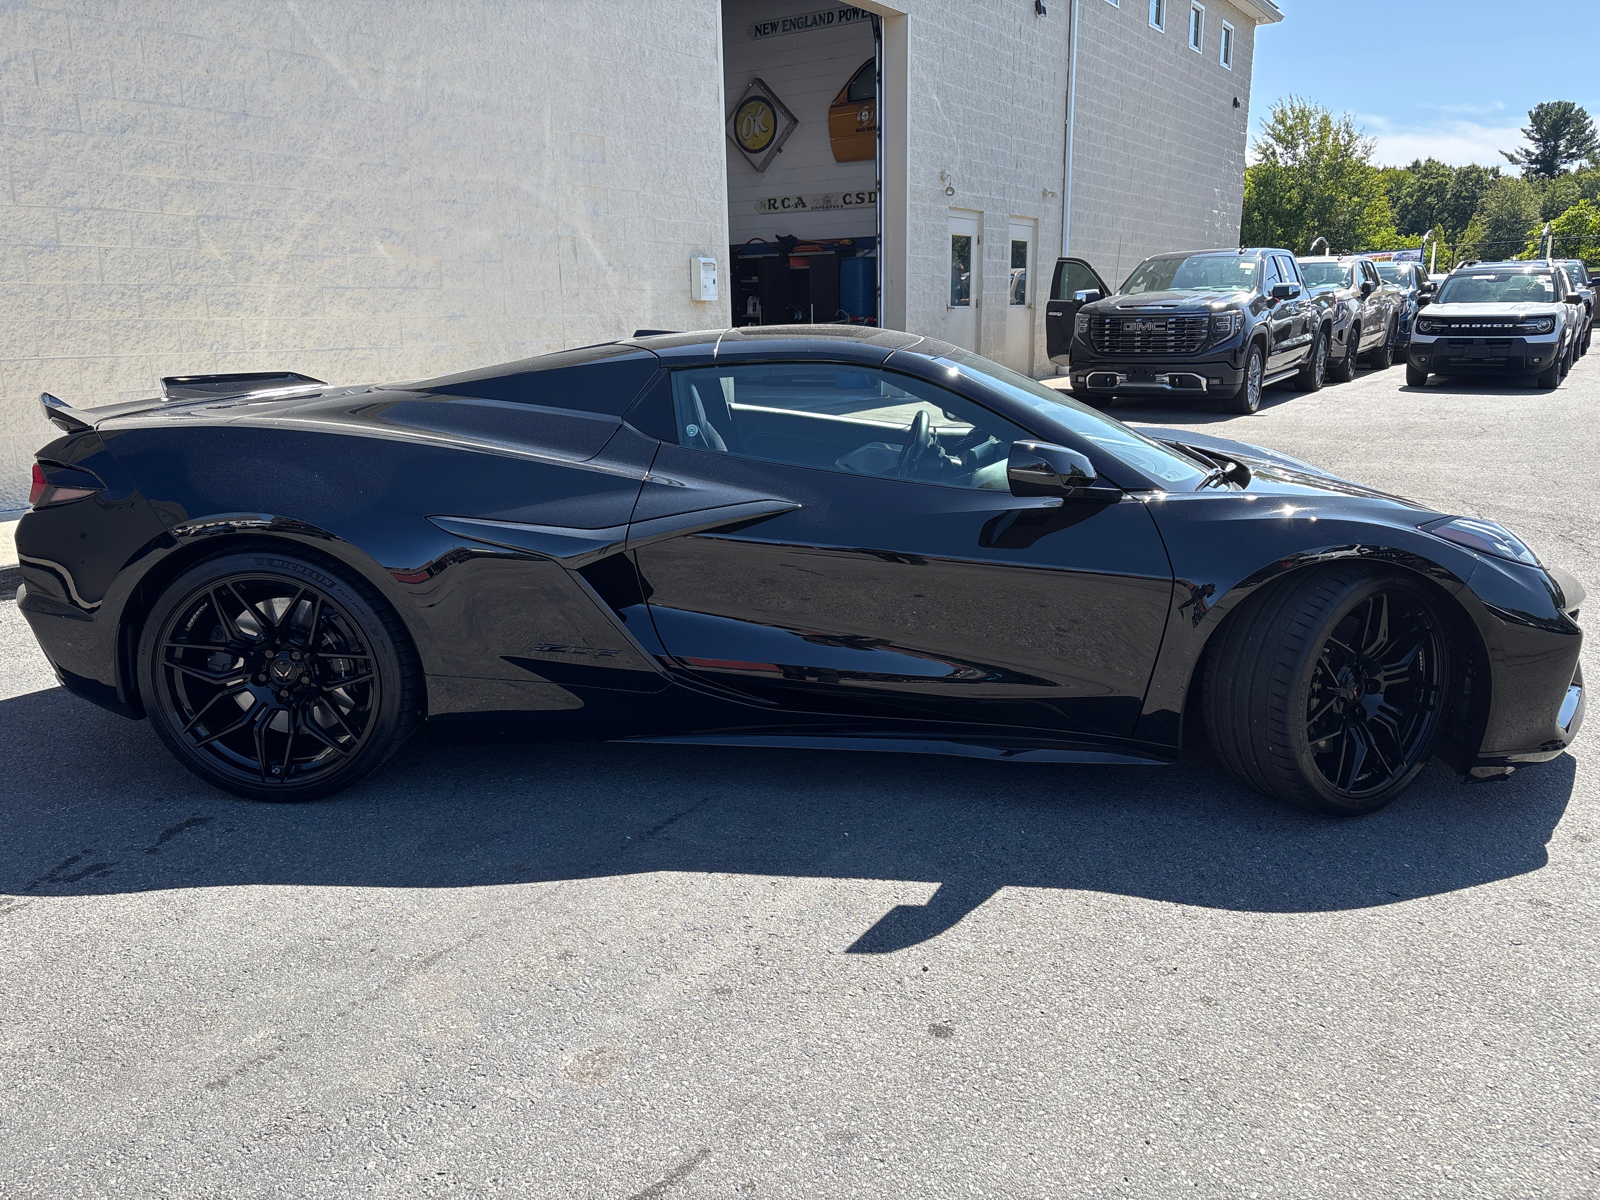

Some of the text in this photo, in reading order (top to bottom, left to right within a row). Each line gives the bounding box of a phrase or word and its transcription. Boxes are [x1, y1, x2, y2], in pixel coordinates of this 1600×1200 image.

[754, 7, 870, 38] NEW ENGLAND POWE
[741, 105, 769, 141] OK
[767, 196, 807, 210] RCA
[1123, 322, 1166, 331] GMC
[271, 559, 333, 587] MICHELIN
[336, 588, 353, 601] PILOT
[351, 601, 368, 618] SPORT
[530, 643, 622, 658] Z06
[1298, 685, 1306, 740] MICHELIN
